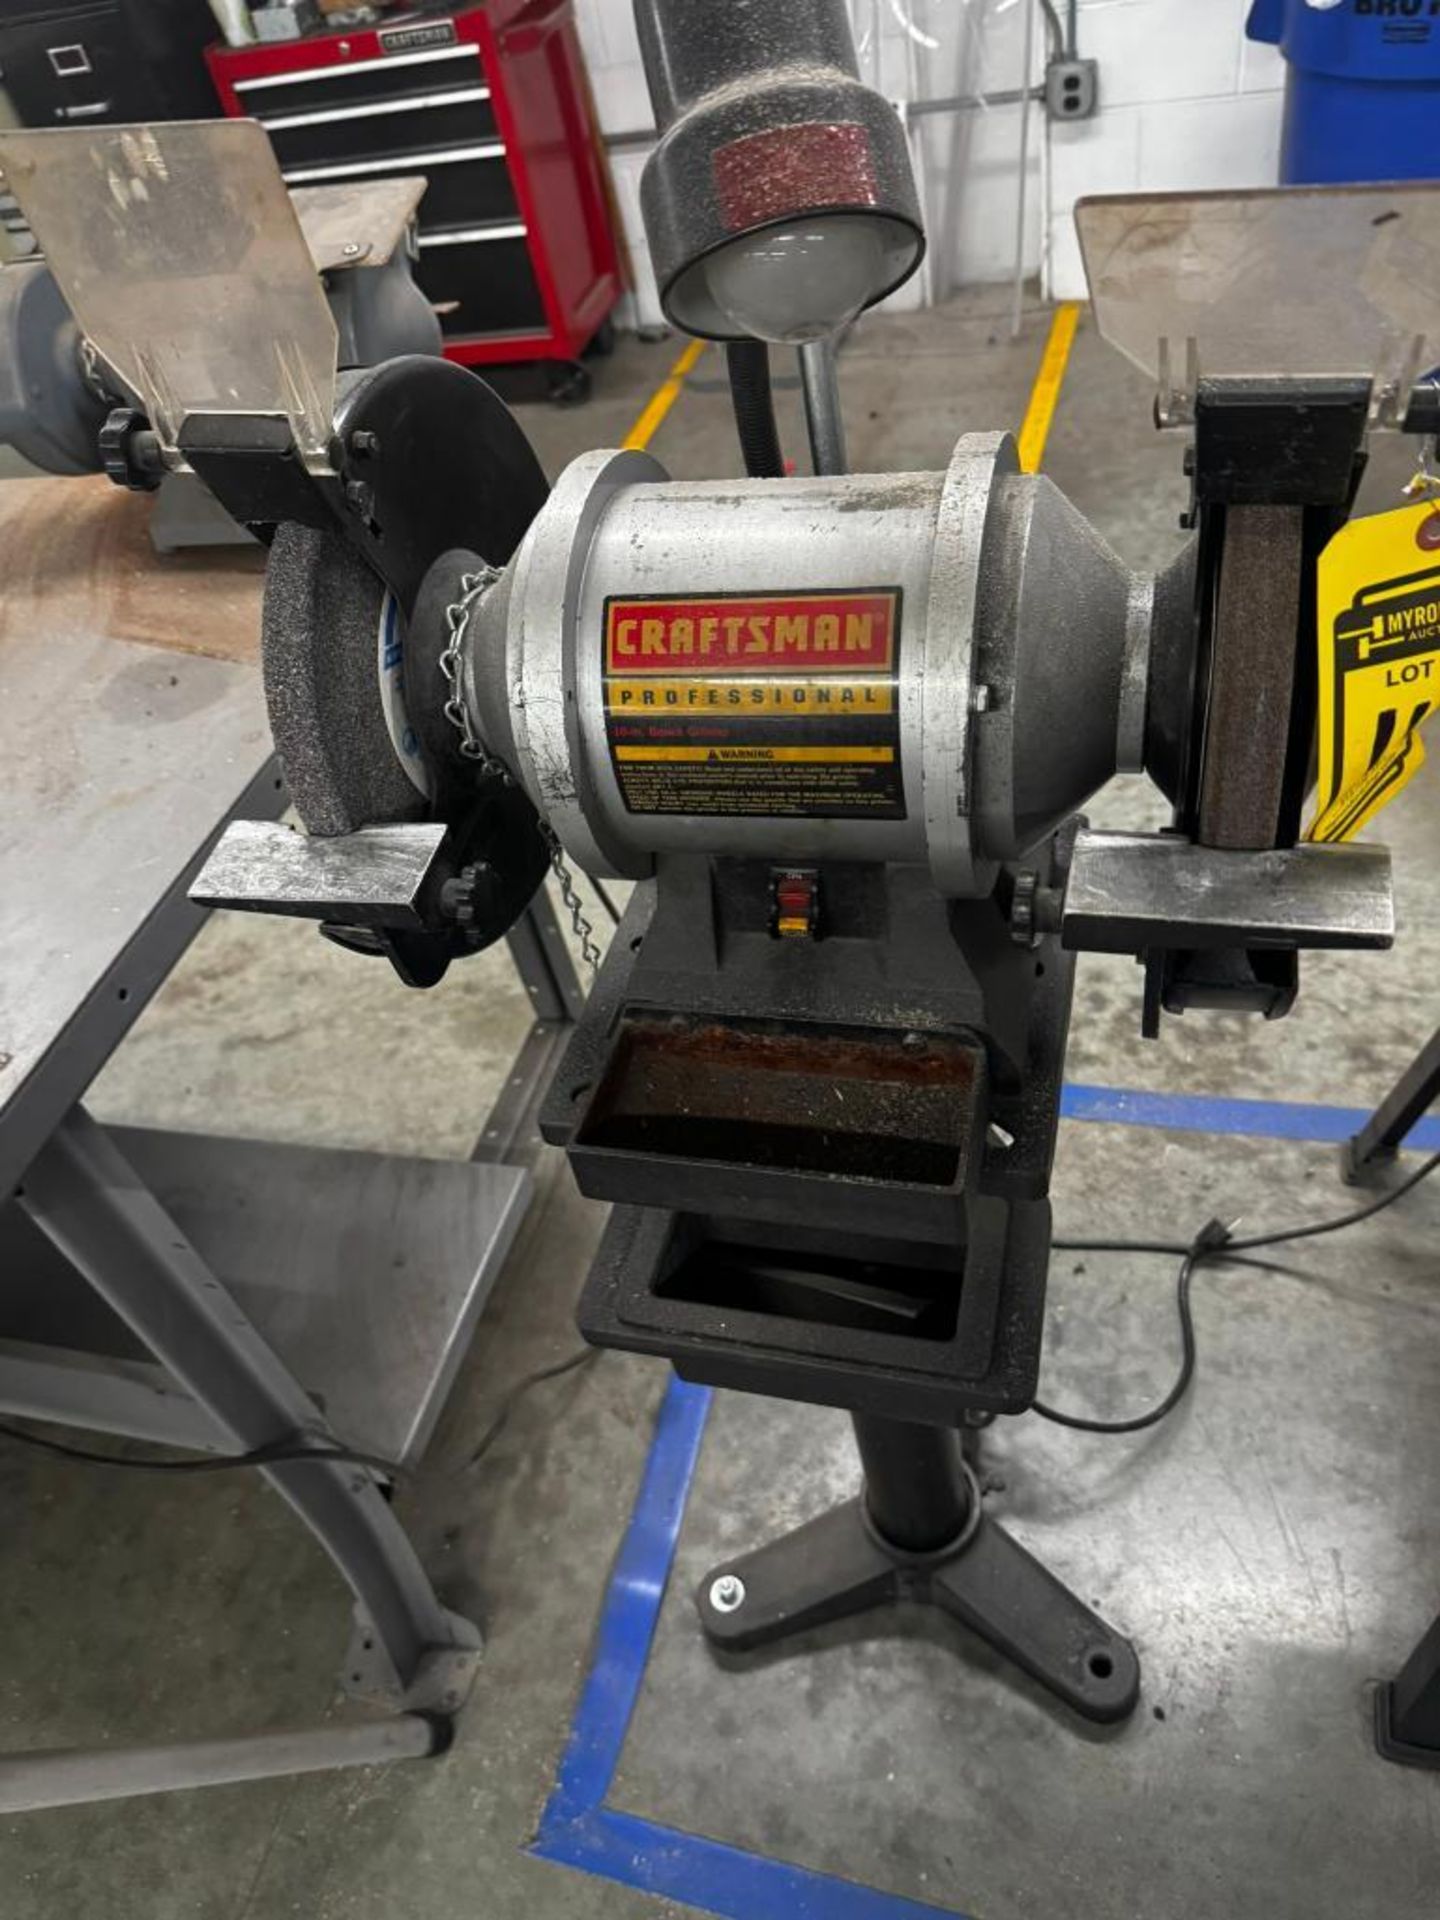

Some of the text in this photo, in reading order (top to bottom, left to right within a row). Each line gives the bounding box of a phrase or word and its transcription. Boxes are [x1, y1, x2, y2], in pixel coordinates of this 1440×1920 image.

[1387, 602, 1440, 634] MYRO
[1386, 659, 1435, 688] LOT
[620, 687, 877, 705] PROFESSIONAL
[720, 749, 774, 760] WARNING
